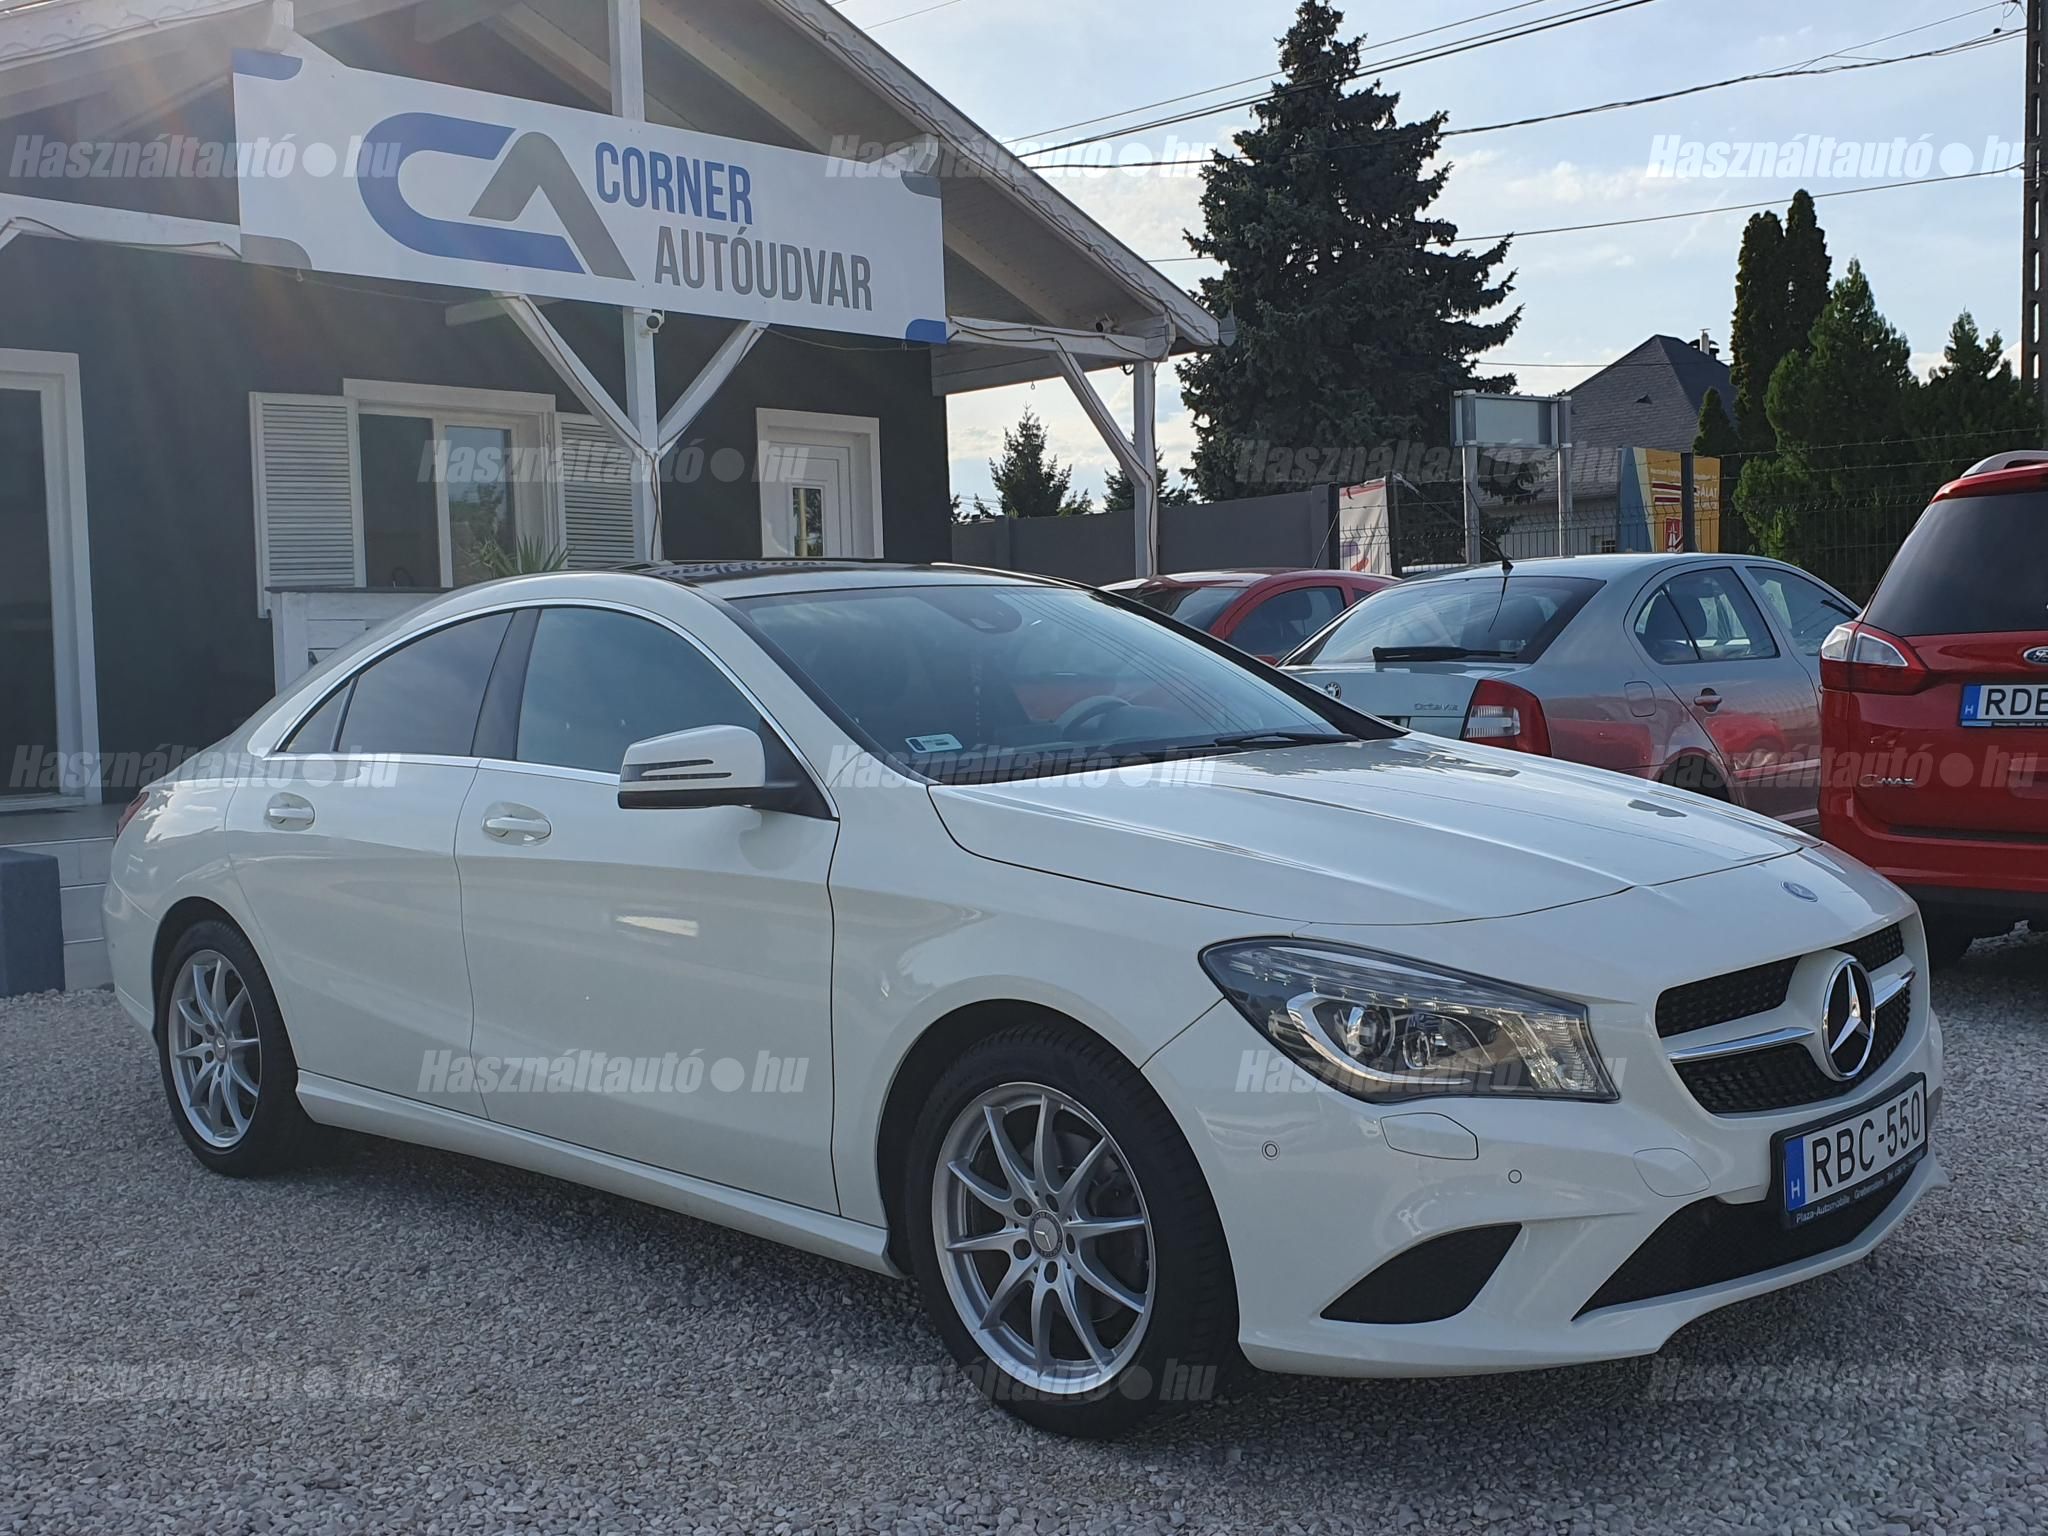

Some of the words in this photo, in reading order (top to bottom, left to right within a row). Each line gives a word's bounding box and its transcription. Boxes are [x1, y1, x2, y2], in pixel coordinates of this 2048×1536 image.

[595, 141, 752, 225] CORNER
[654, 226, 872, 311] AUTÓUDVAR
[1964, 704, 1974, 715] H
[1811, 1090, 1921, 1194] RBC-550
[1791, 1178, 1801, 1200] H
